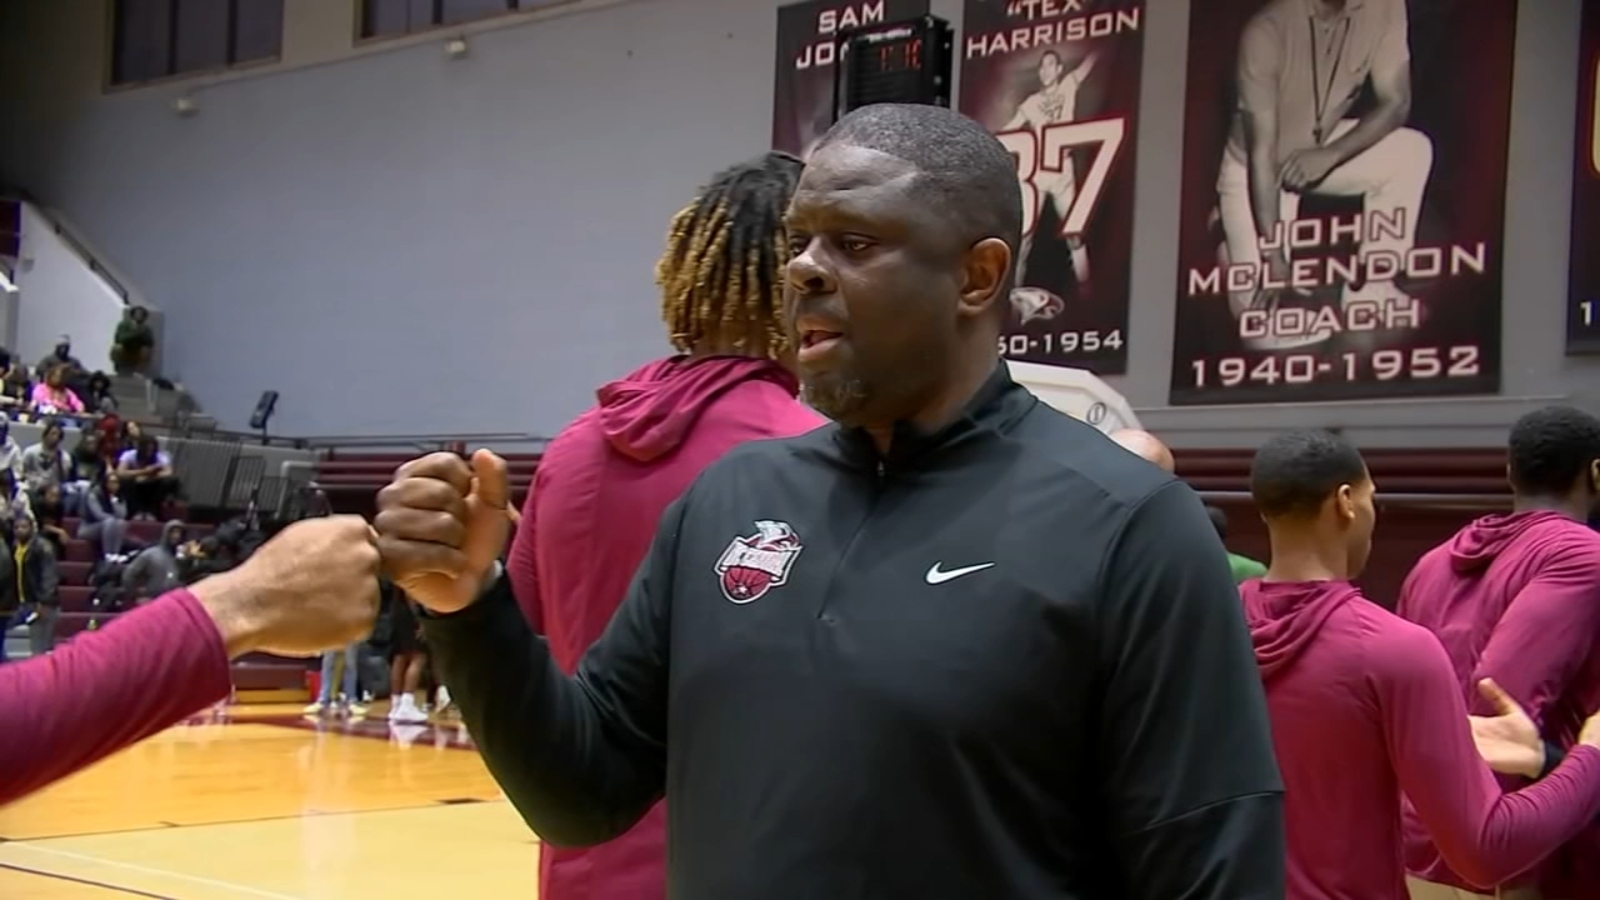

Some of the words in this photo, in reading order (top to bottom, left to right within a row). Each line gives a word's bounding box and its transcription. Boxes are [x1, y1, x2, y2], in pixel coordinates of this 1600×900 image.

[818, 0, 885, 34] SAM
[966, 7, 1140, 60] HARRISON
[1258, 207, 1407, 250] JOHN
[1188, 242, 1486, 296] MCLENDON
[1239, 299, 1421, 338] COACH
[998, 329, 1124, 355] 50-1954
[1191, 345, 1480, 387] 1940-1952
